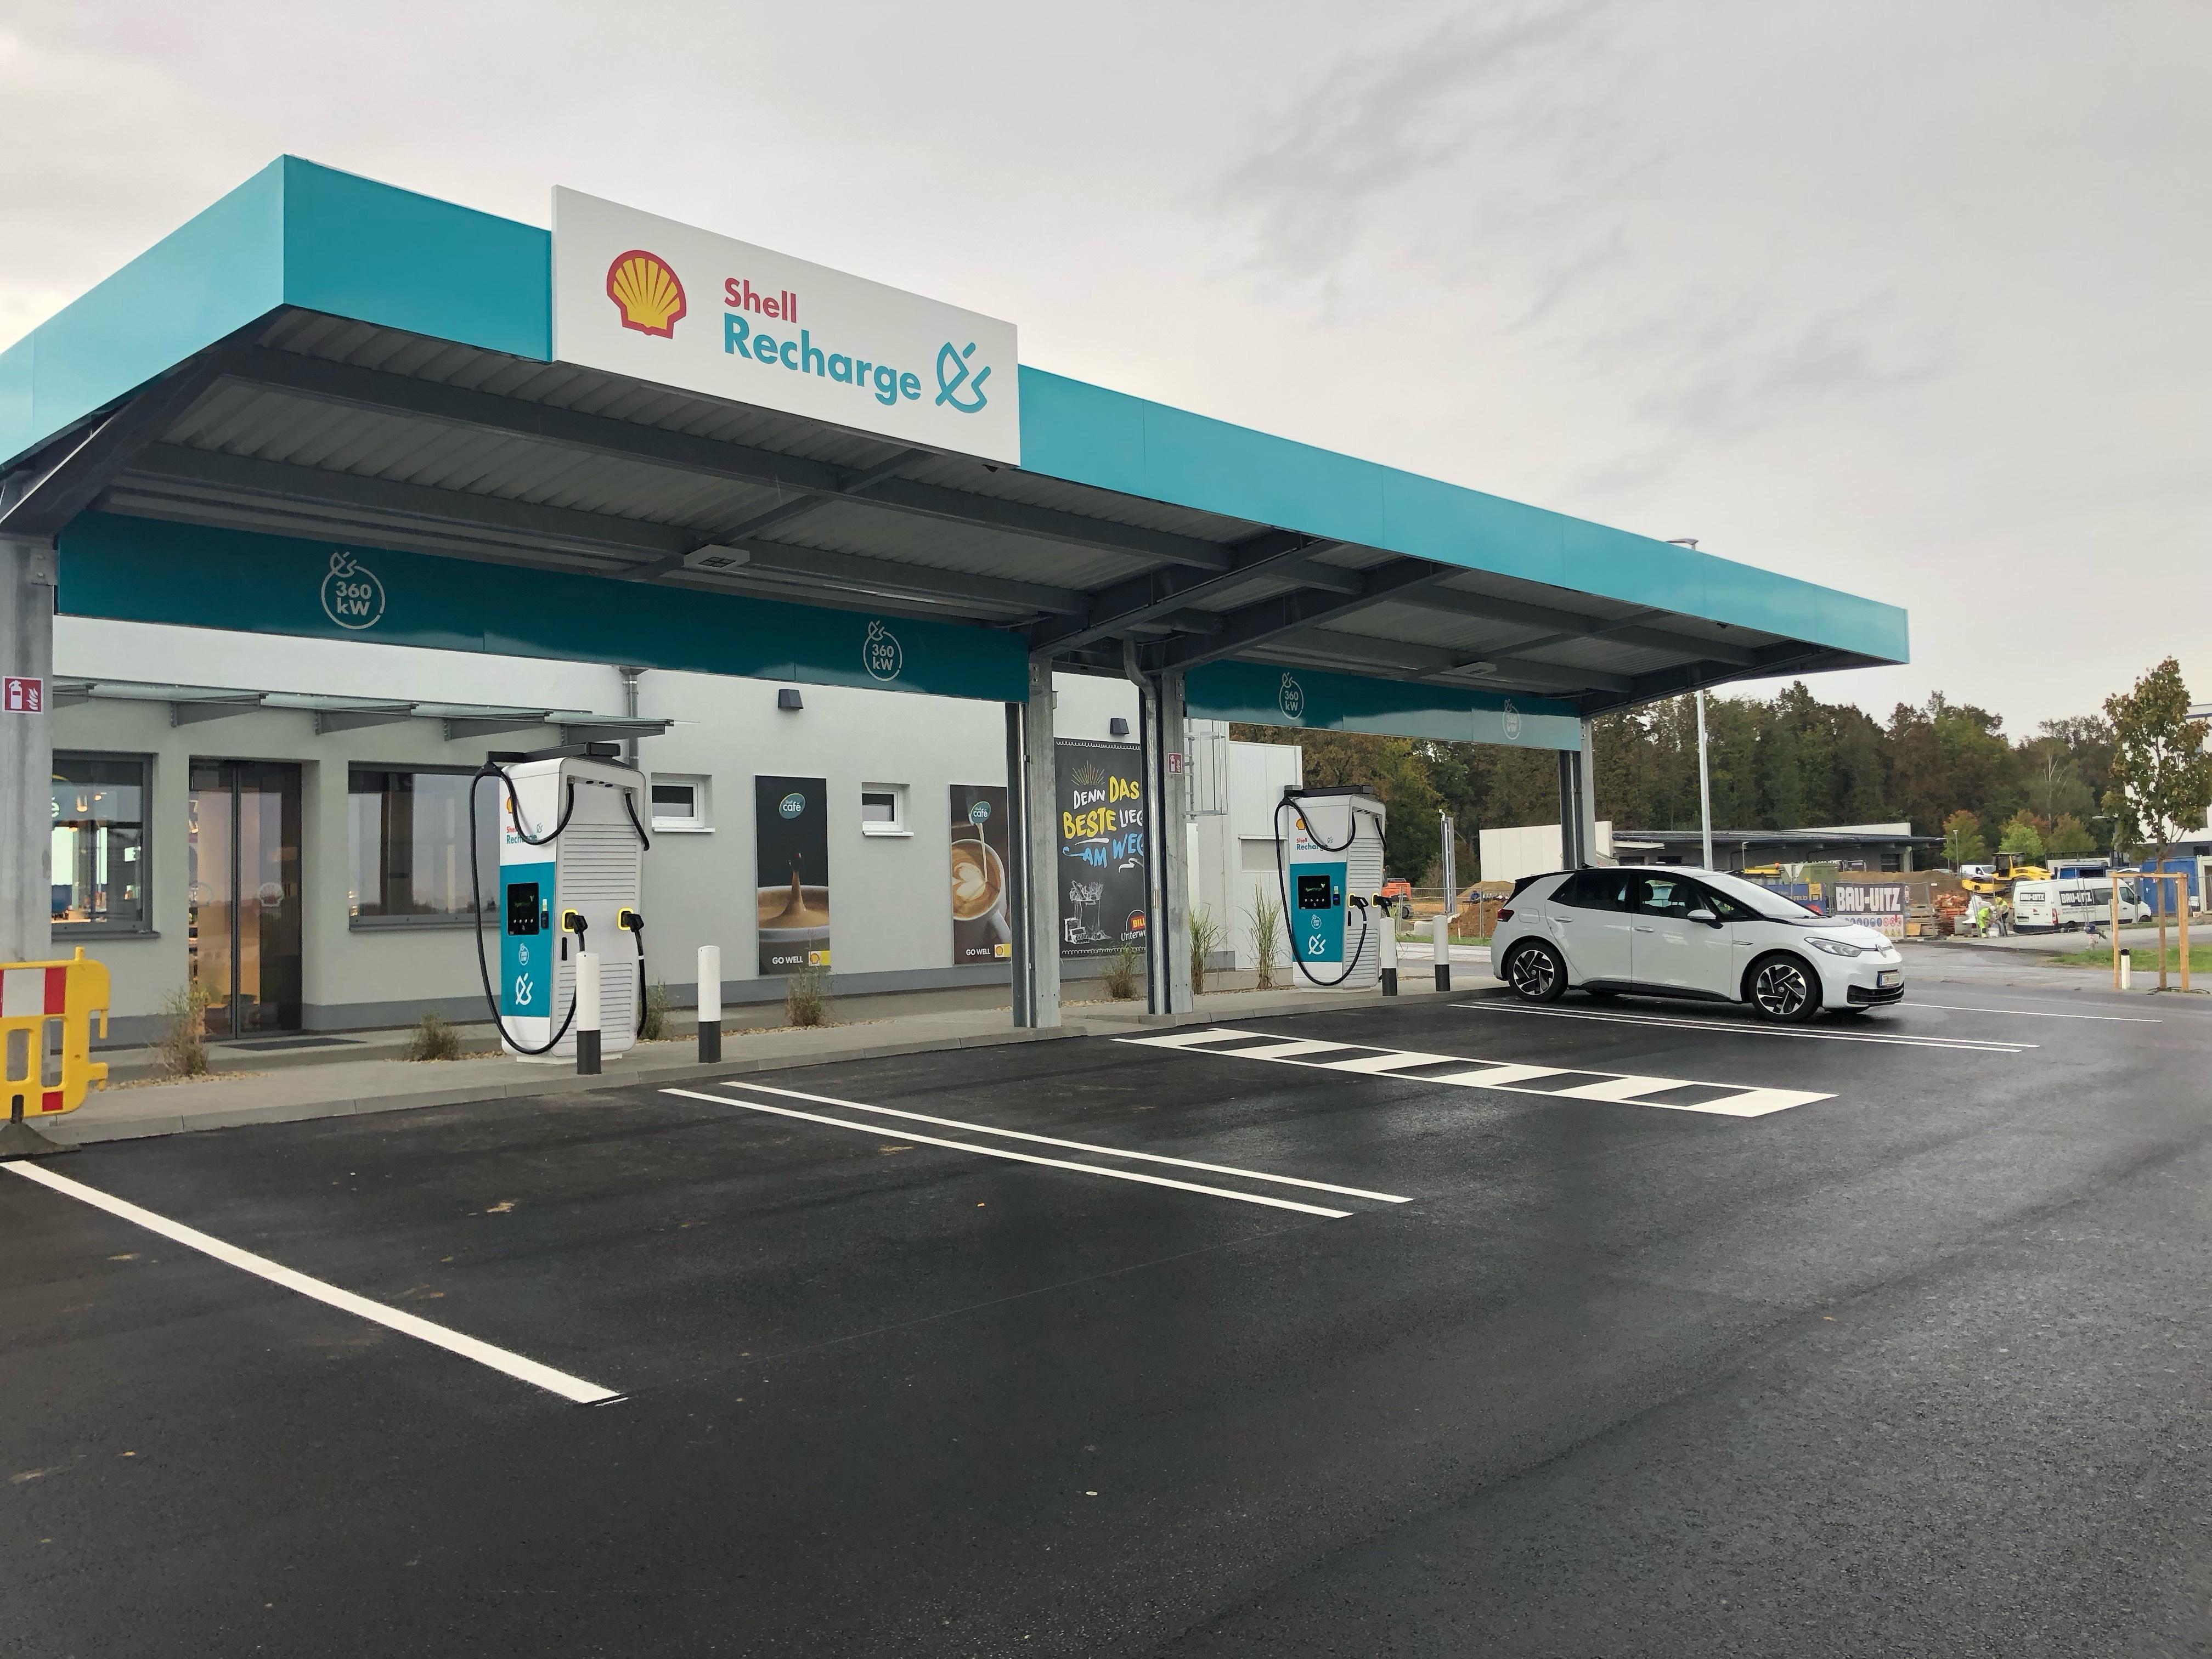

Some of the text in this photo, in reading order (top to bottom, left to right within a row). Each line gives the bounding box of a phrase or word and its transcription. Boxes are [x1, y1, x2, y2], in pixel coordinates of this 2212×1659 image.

[724, 278, 797, 324] Shell
[724, 312, 921, 406] Recharge
[336, 581, 372, 599] 360
[337, 597, 371, 616] kW
[872, 644, 894, 658] 360
[873, 656, 894, 670] kW
[1284, 691, 1299, 701] 360
[1285, 700, 1298, 711] kW
[1073, 776, 1140, 809] DENN DAS
[783, 801, 802, 811] café
[973, 808, 988, 817] café
[1063, 807, 1117, 839] BESTE
[1074, 847, 1107, 868] AM
[772, 956, 804, 964] GO WELL
